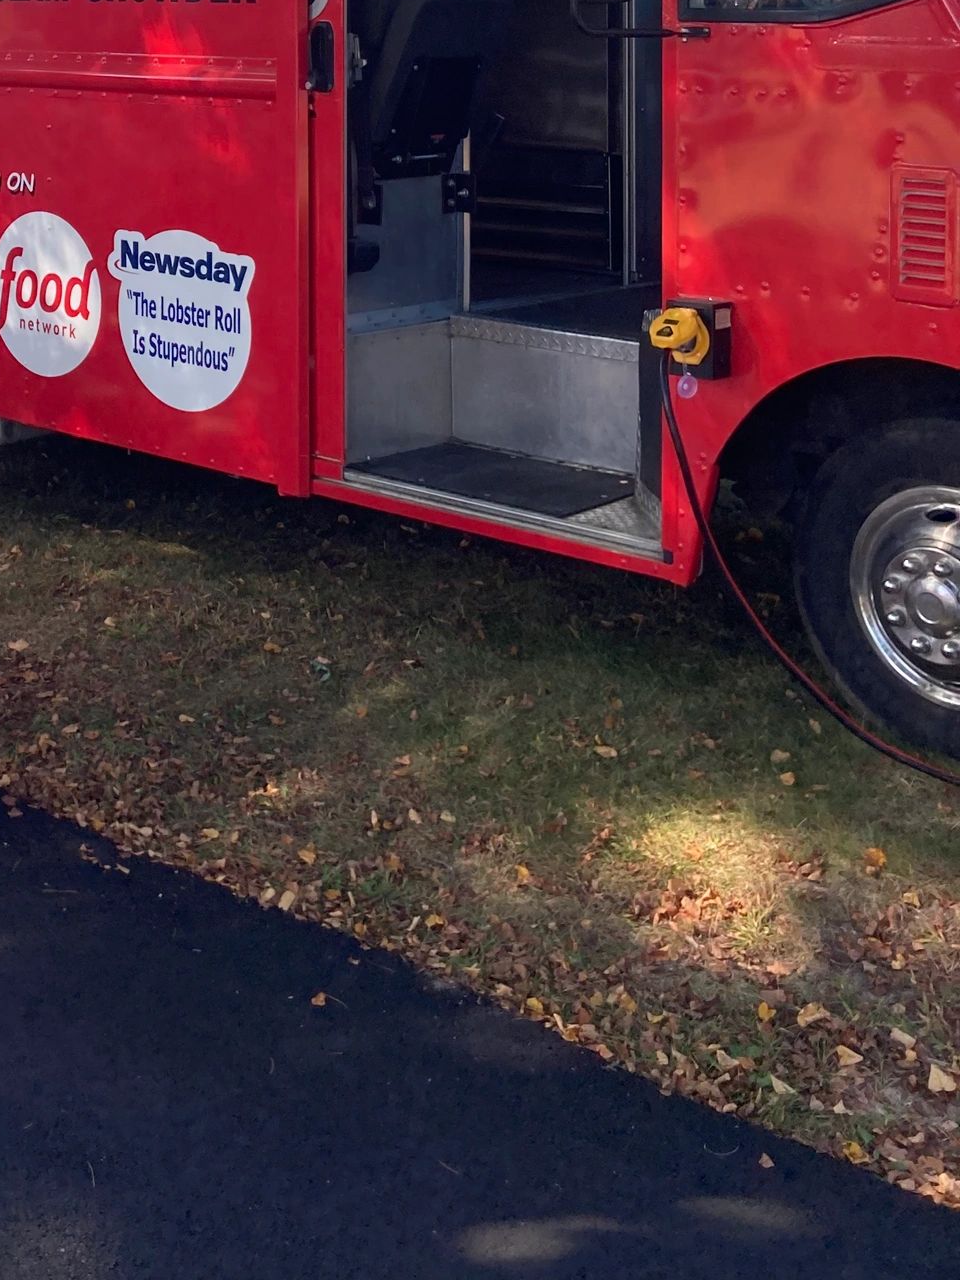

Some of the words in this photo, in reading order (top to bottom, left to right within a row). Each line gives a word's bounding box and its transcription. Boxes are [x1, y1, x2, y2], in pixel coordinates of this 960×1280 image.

[6, 171, 36, 193] ON
[119, 239, 248, 292] Newsday
[19, 316, 77, 340] network
[160, 296, 210, 329] Lobster
[214, 304, 241, 335] Roll
[132, 329, 146, 355] Is
